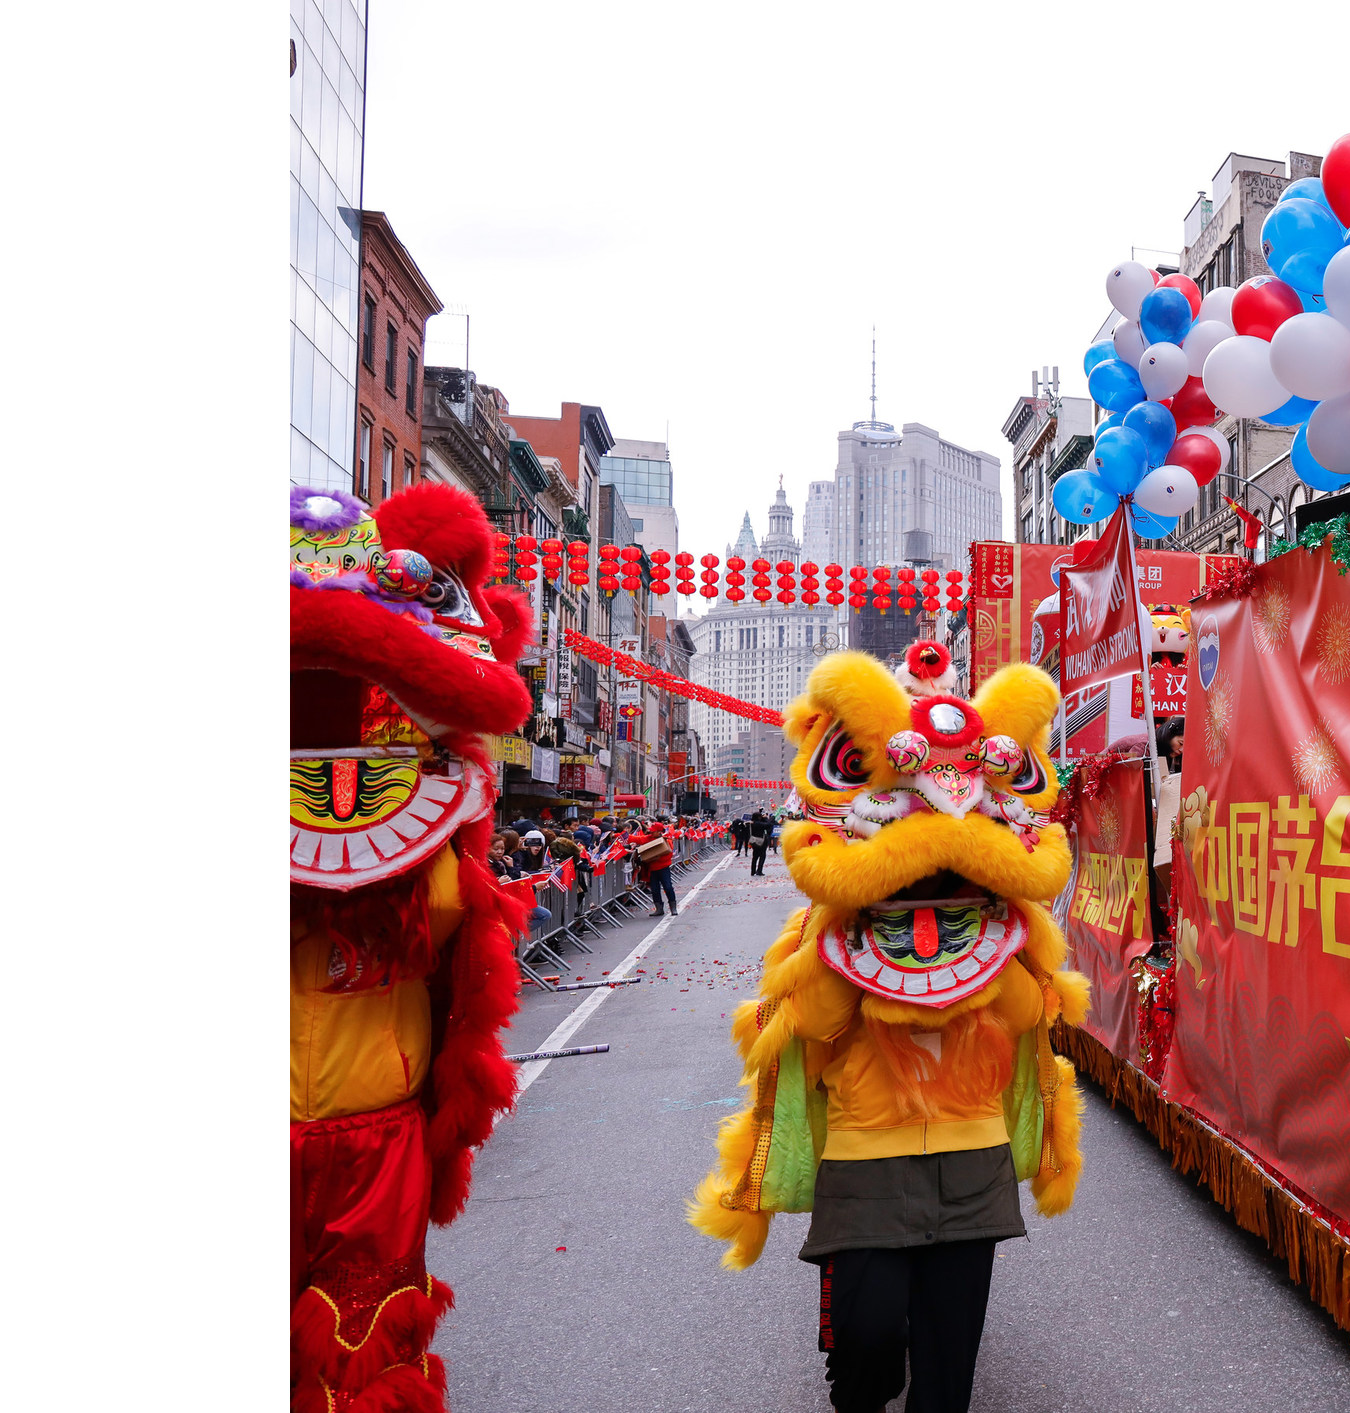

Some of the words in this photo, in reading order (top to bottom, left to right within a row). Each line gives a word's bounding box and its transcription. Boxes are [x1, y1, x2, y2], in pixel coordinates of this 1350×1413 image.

[1138, 582, 1162, 590] ROUP
[1065, 652, 1092, 681] WUHAN
[1090, 642, 1109, 669] STAY
[1108, 621, 1139, 665] STRONG
[1151, 702, 1178, 712] HAN
[821, 1278, 833, 1309] UNITED
